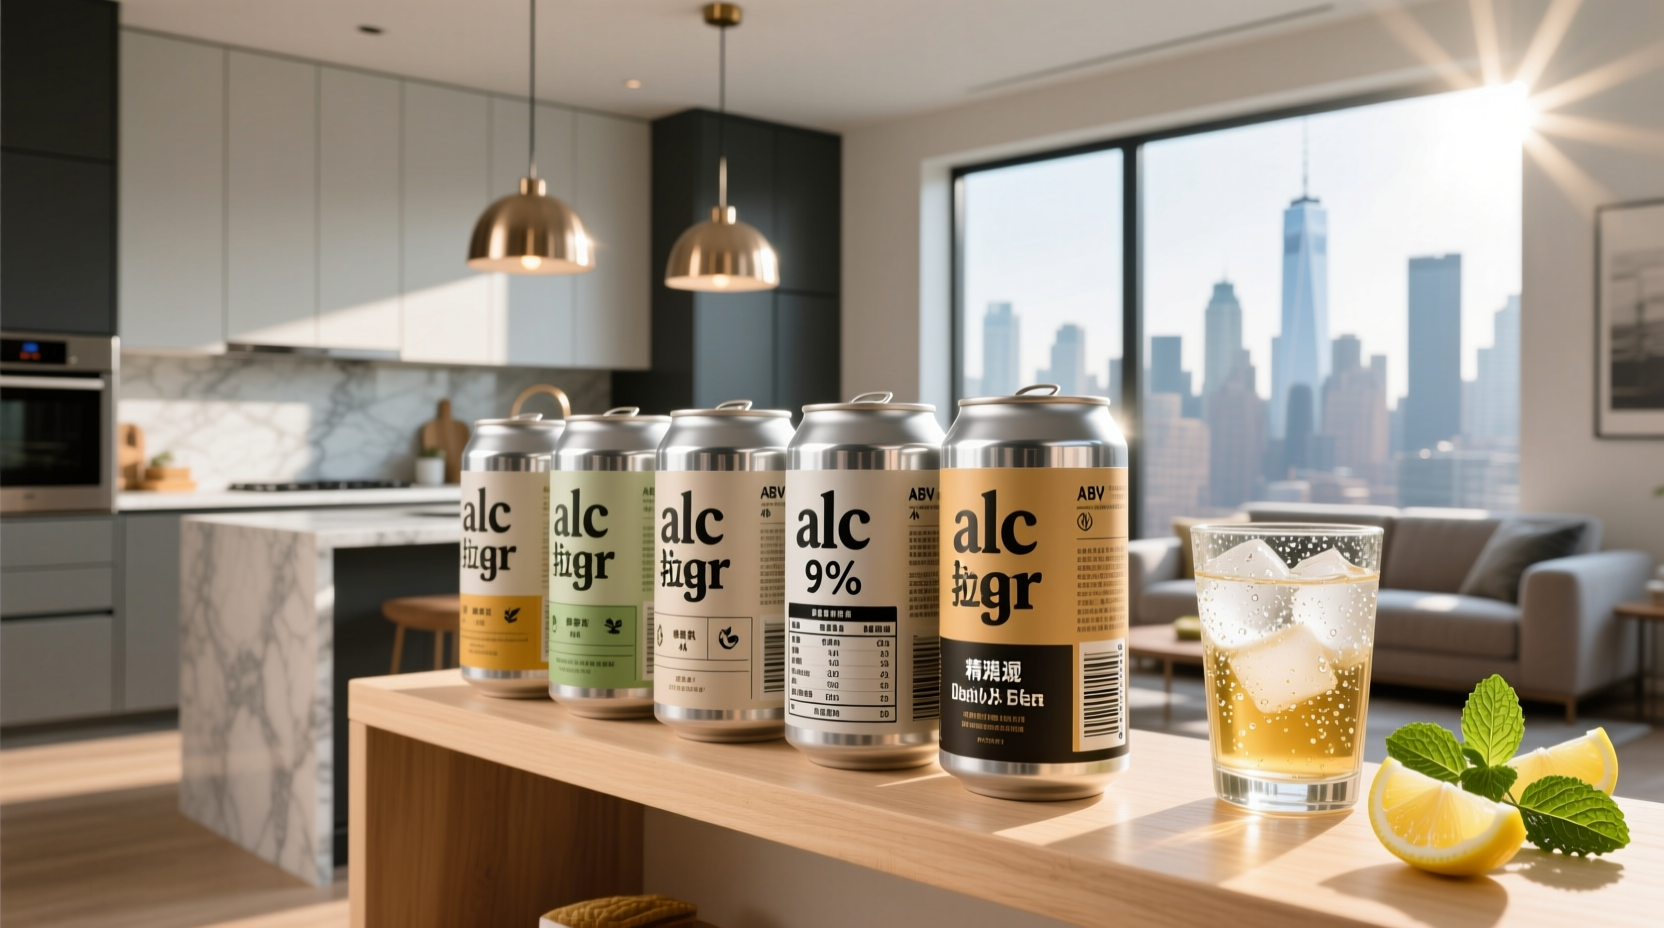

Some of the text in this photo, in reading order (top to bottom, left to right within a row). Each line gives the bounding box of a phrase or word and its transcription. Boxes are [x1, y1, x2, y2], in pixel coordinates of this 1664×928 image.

[463, 487, 511, 533] alc
[554, 488, 609, 538] alc
[760, 486, 785, 499] ABV
[909, 487, 935, 501] ABV
[1077, 486, 1105, 501] ABV
[661, 490, 724, 545] alc
[796, 490, 870, 550] alc
[953, 489, 1038, 555] alc
[805, 559, 862, 595] 9%
